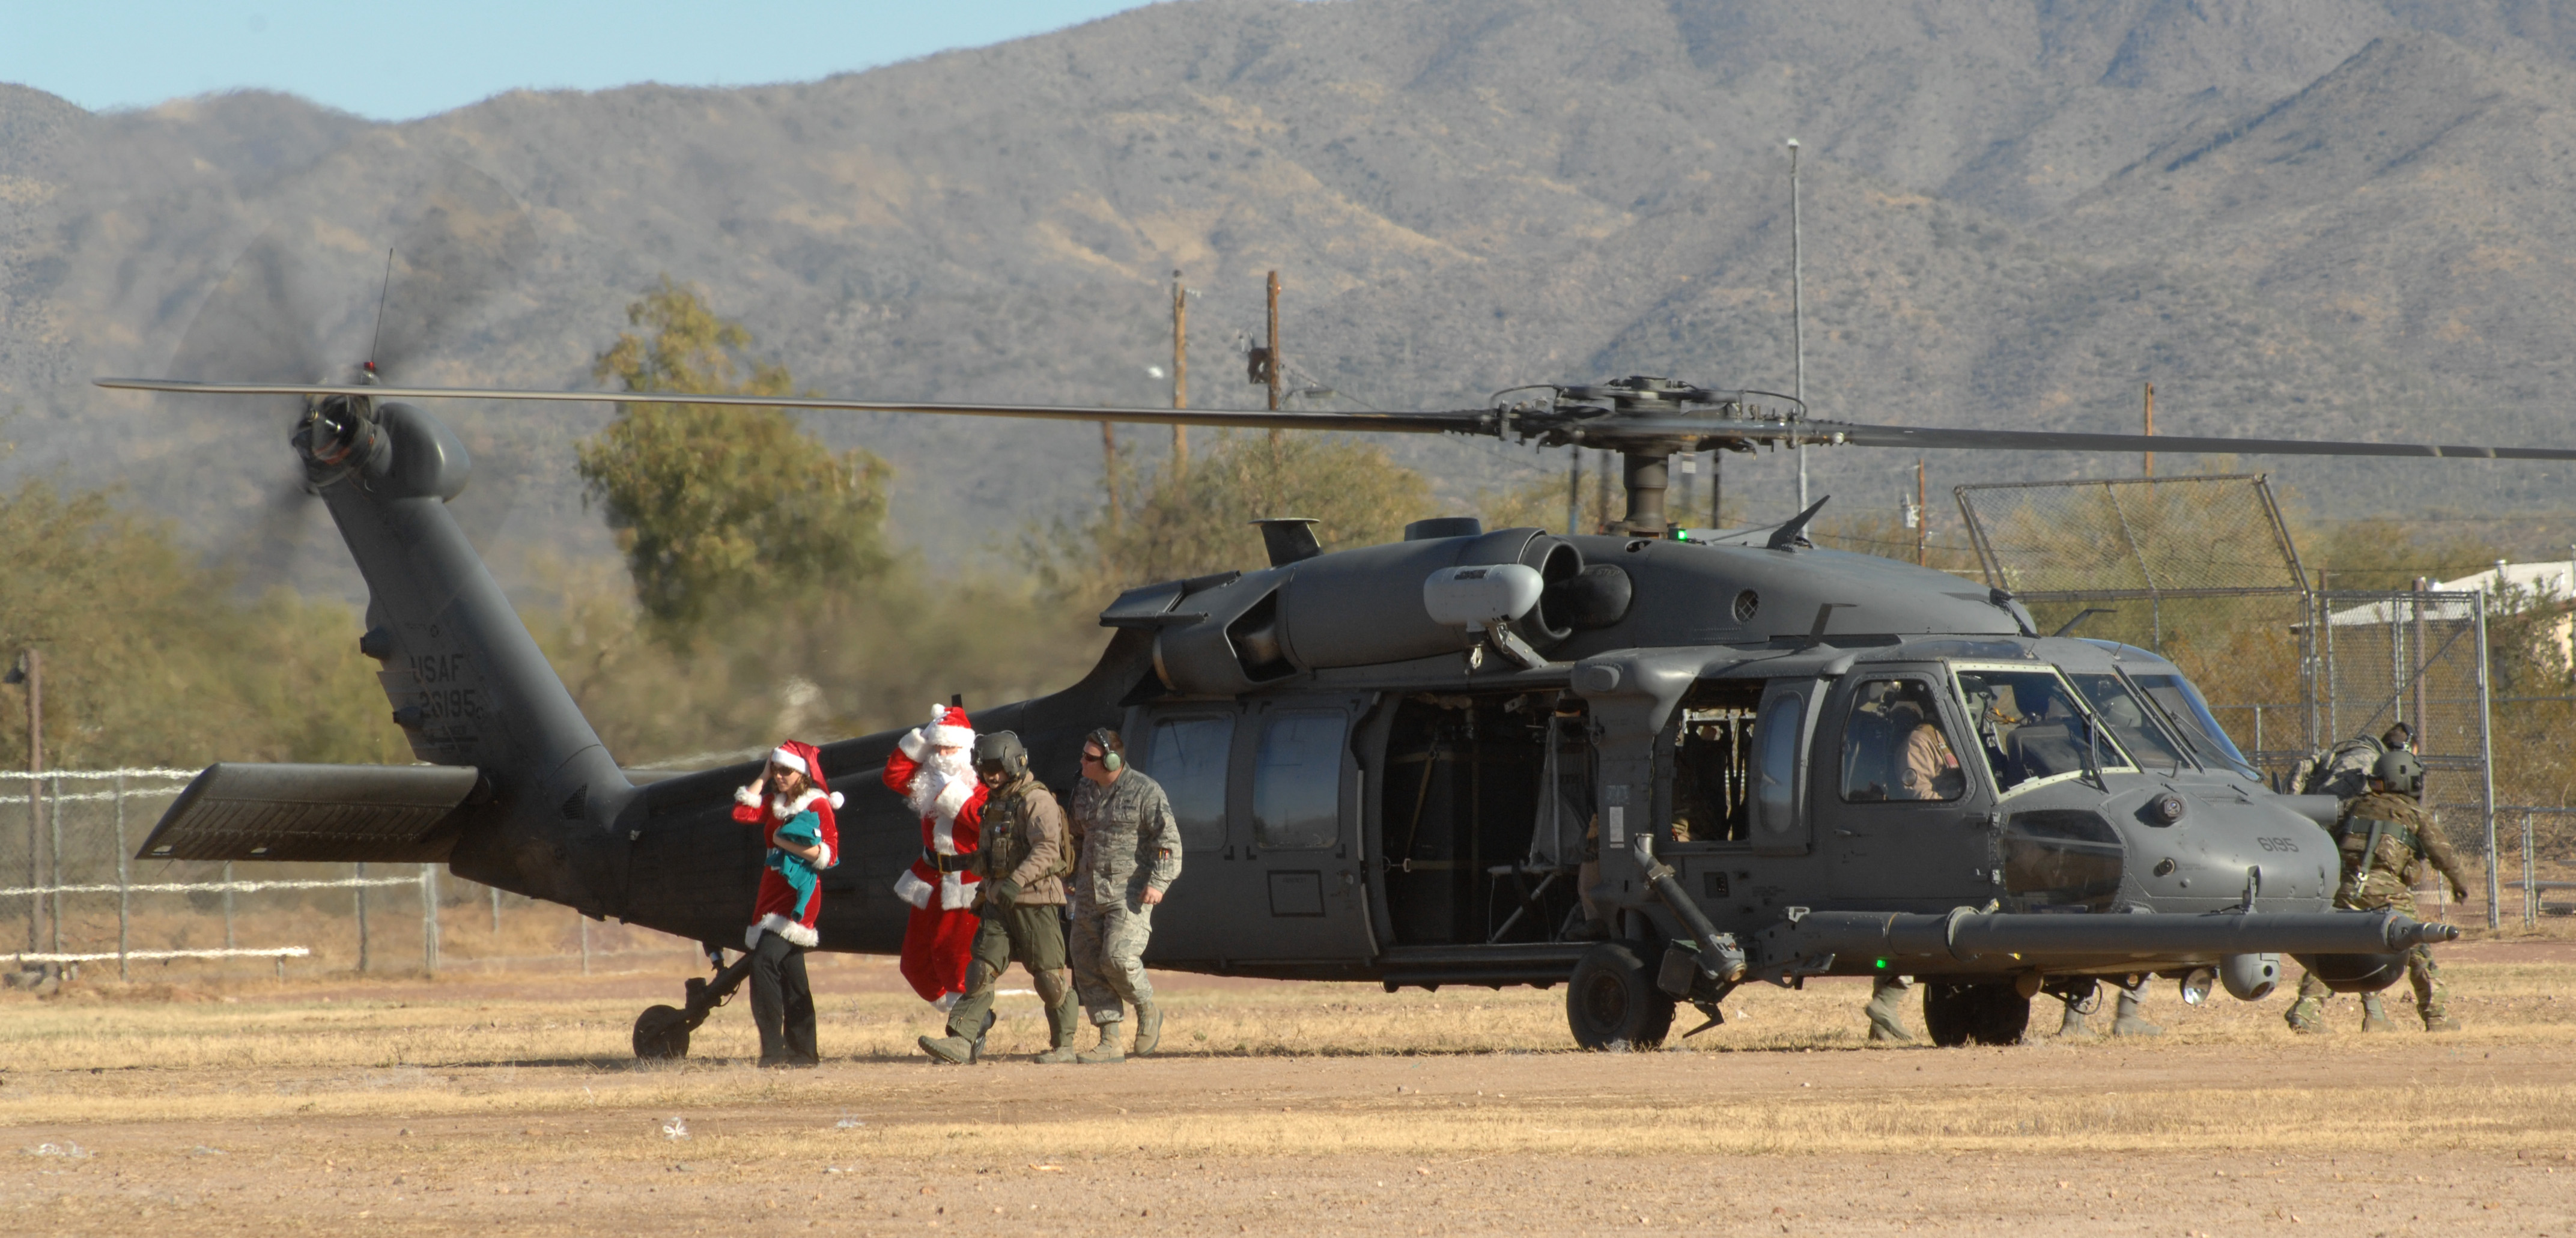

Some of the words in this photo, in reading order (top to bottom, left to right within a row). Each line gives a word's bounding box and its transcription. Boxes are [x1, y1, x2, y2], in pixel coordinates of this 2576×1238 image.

[410, 654, 464, 682] USAF
[419, 689, 476, 719] 26195
[2257, 837, 2299, 852] 6195
